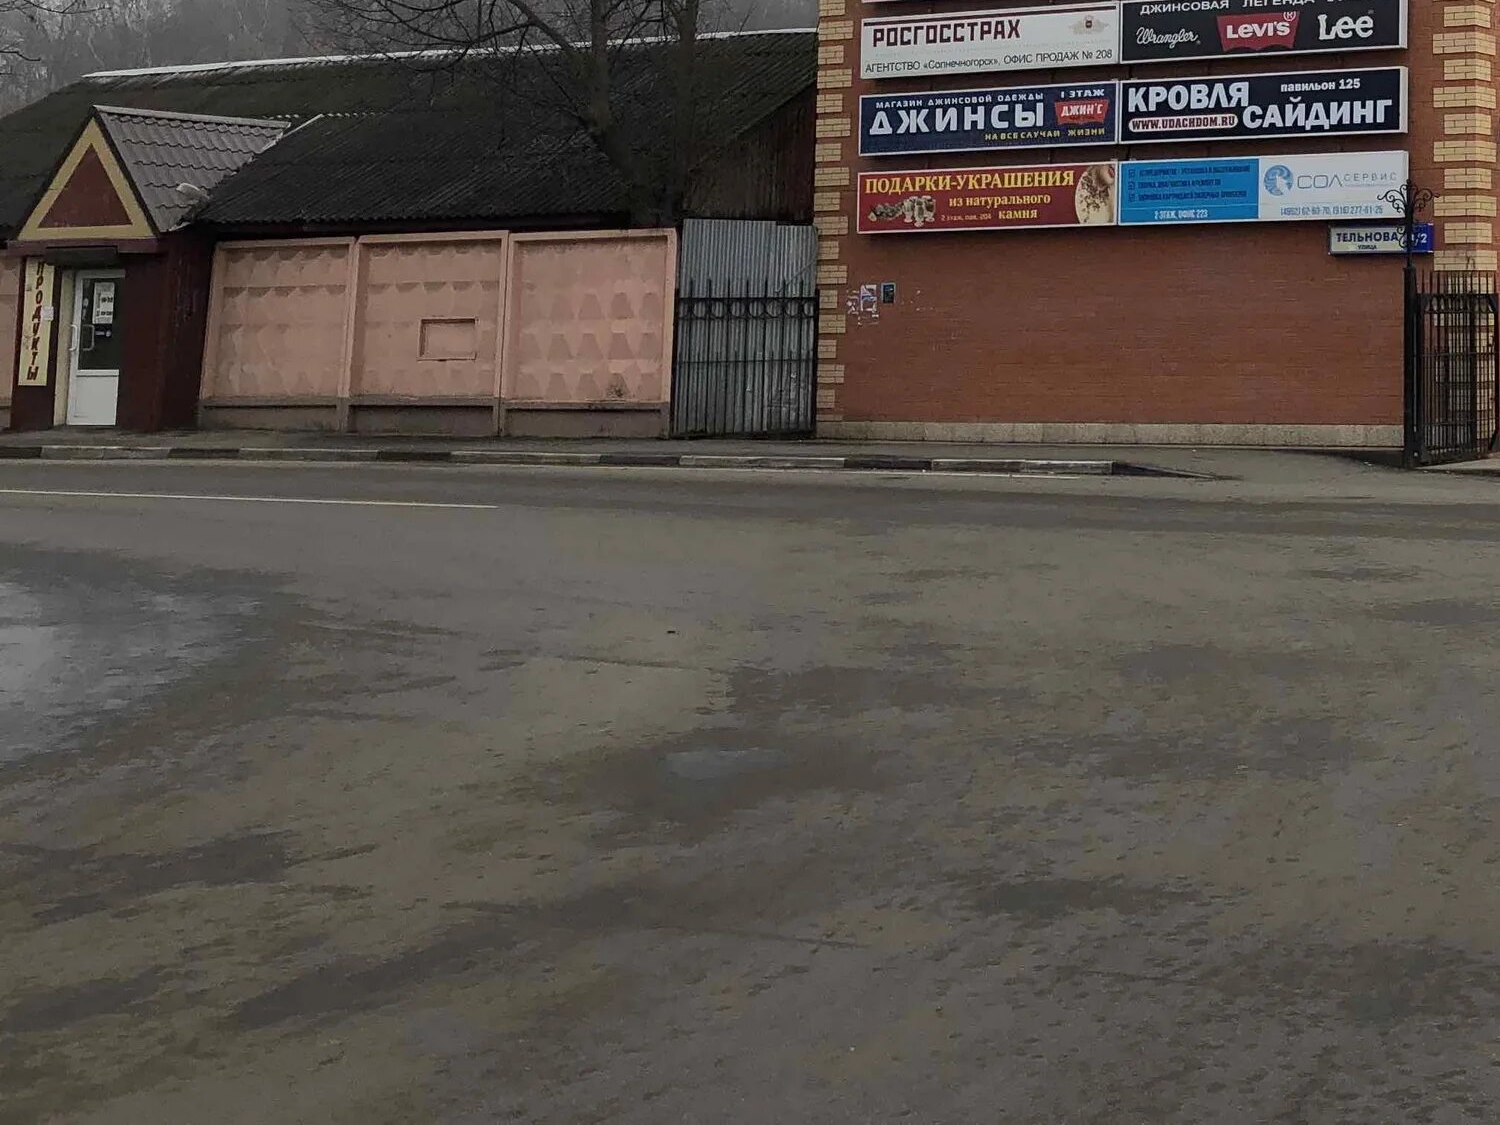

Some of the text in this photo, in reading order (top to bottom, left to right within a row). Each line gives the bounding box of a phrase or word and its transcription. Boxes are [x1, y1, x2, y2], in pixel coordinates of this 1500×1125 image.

[1139, 0, 1230, 16] ДЖИНСОВАЯ
[873, 19, 1021, 47] РОСГОССТРАХ
[1317, 13, 1374, 41] Lee
[1135, 26, 1200, 49] Wrangler
[865, 59, 920, 73] АГЕНТСТВО
[1003, 54, 1033, 65] ОФИС
[1036, 50, 1080, 63] ПРОДАЖ
[1082, 51, 1093, 61] №
[1095, 49, 1113, 60] 208
[1069, 89, 1105, 98] ЭТАЖ
[1280, 78, 1361, 93] павильон 125
[876, 92, 1044, 109] МАГАЗИН ДЖИНСОВОЙ ОДЕЖДЫ
[1128, 81, 1249, 113] КРОВЛЯ
[869, 102, 1044, 135] ДЖИНСЫ
[1242, 96, 1393, 130] САЙДИНГ
[1132, 115, 1235, 131] WWW.UDACHDOM.RU
[984, 128, 1105, 141] НА ВСЕ СЛУЧАИ ЖИЗНИ
[865, 170, 1075, 195] ПОДАРКИ-УКРАШЕНИЯ
[1297, 172, 1397, 189] СОЛ СЕРВИС
[949, 193, 1051, 209] из натурального
[998, 209, 1038, 220] камня
[1336, 232, 1400, 243] ТЕЛЬНОВА
[27, 261, 44, 381] ПРОДУКТЫ
